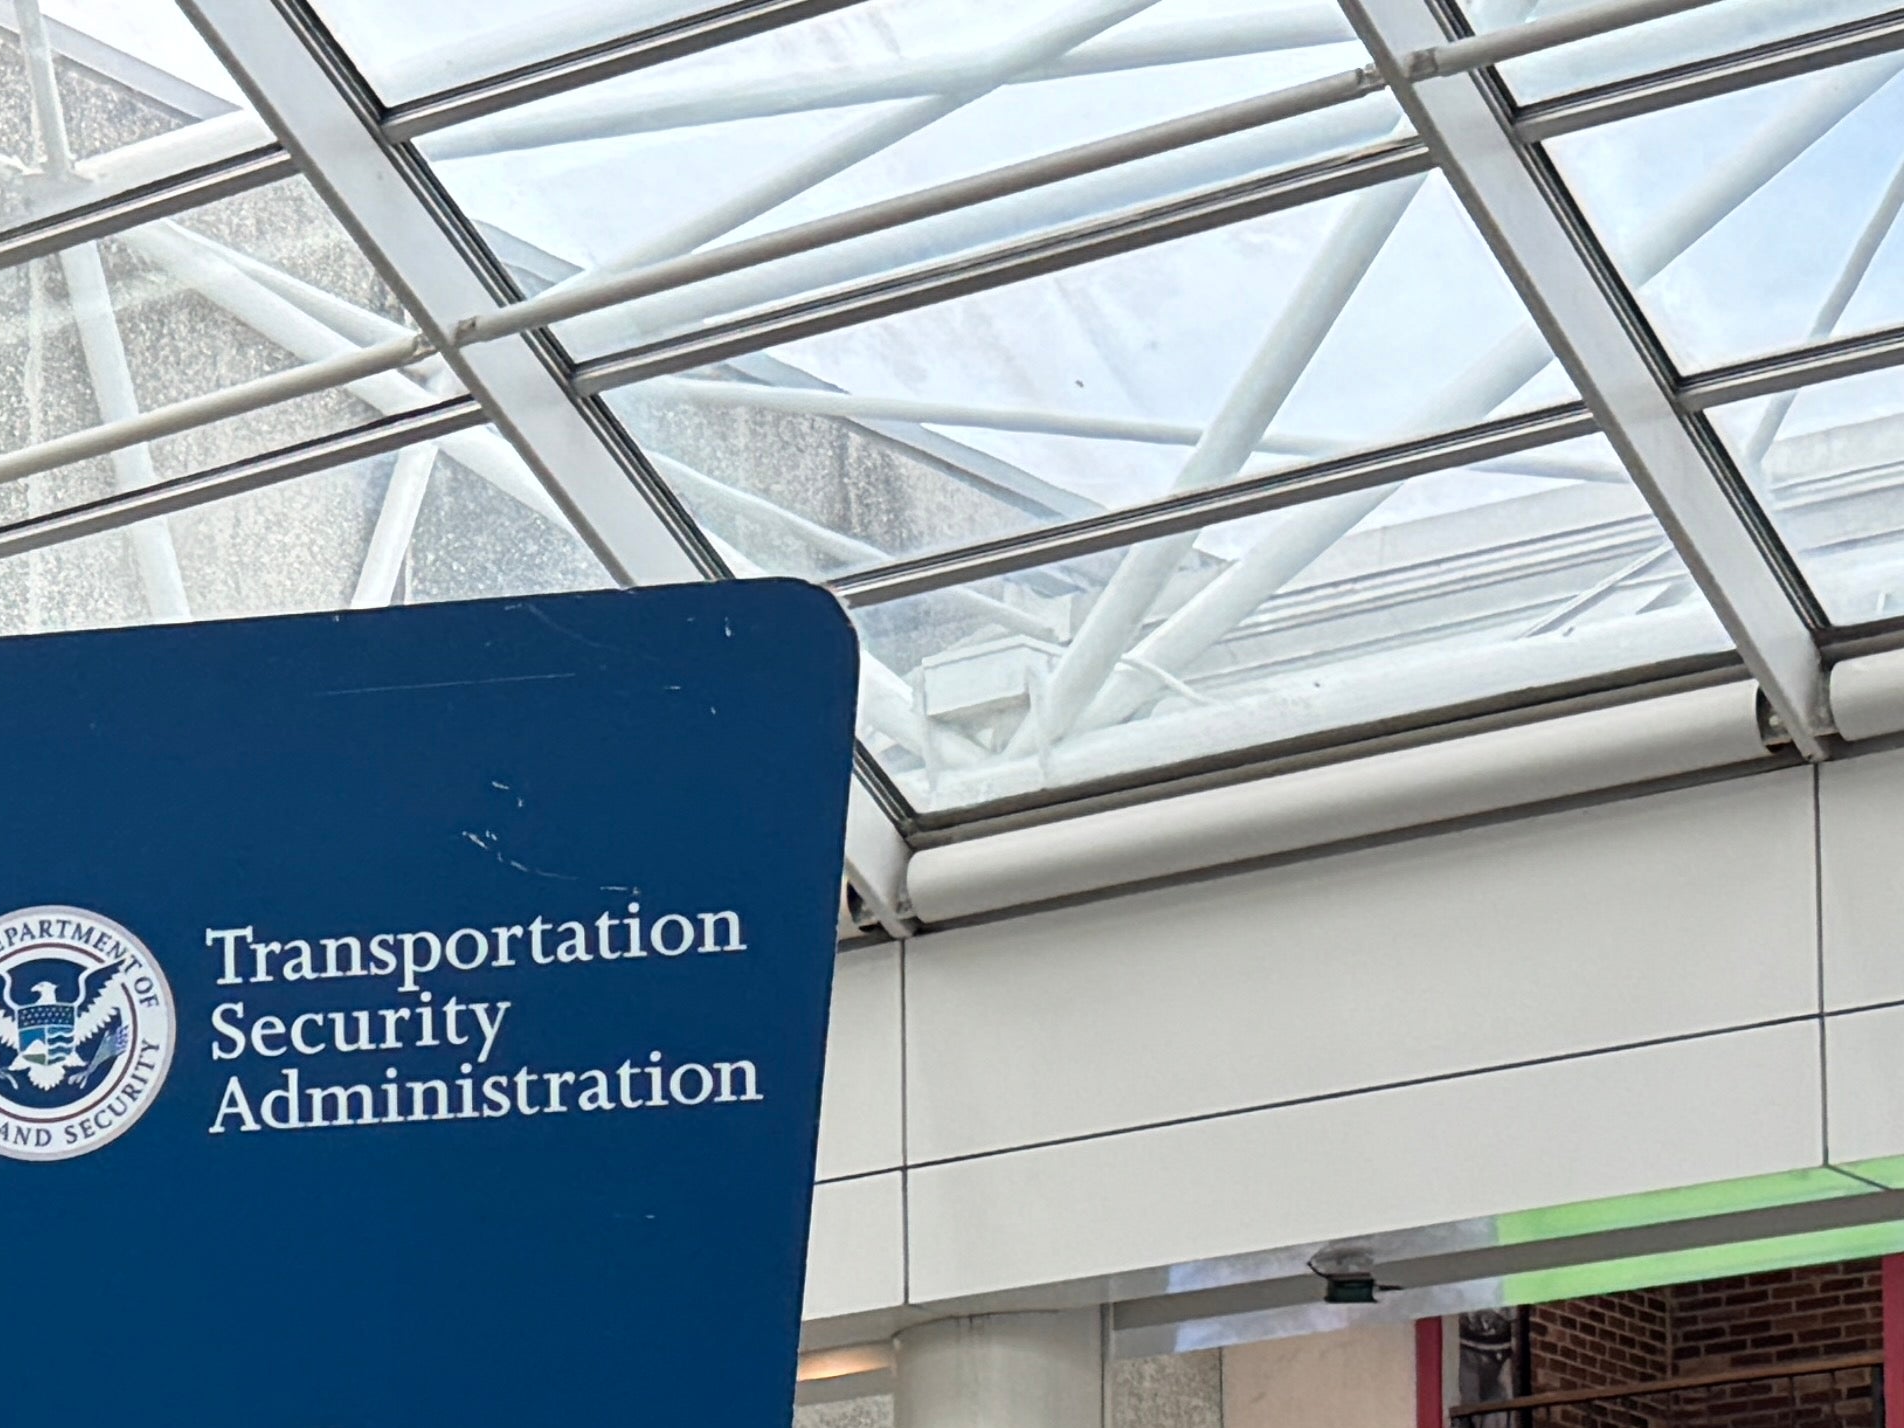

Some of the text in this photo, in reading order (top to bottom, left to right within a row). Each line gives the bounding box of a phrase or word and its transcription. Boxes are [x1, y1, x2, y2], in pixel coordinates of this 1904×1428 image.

[204, 901, 748, 993] Transportation
[133, 977, 160, 1009] OF
[210, 990, 513, 1065] Security
[65, 1039, 161, 1146] SECURITY
[207, 1050, 765, 1135] Administration
